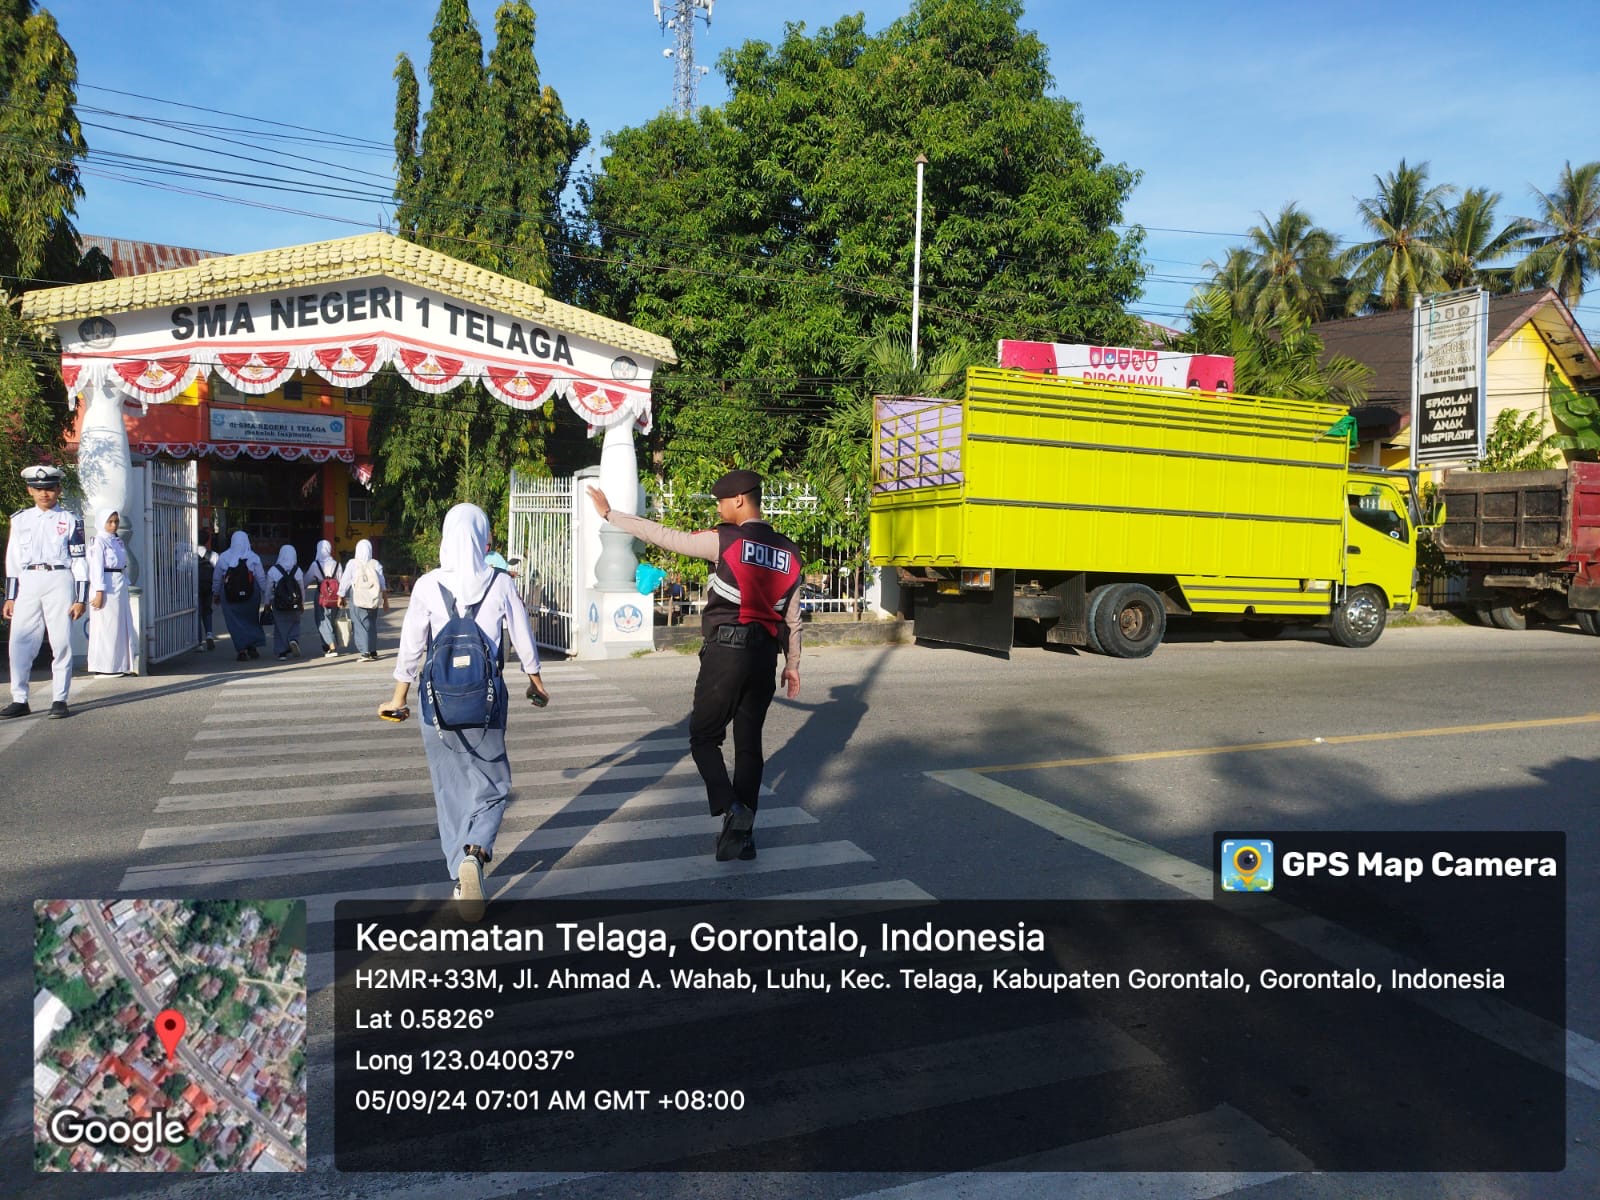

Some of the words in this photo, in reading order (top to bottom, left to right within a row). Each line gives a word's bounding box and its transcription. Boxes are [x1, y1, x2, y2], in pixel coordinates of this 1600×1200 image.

[171, 302, 255, 340] SMA
[270, 286, 403, 331] NEGERI
[416, 296, 430, 329] 1
[443, 302, 575, 367] TELAGA
[1425, 393, 1473, 409] SEKOLAH
[1428, 406, 1467, 420] RAMAH
[297, 425, 327, 433] TELAGA
[1433, 418, 1464, 431] ANAK
[1421, 429, 1475, 444] INSPIRATIF
[744, 542, 790, 572] POLISI
